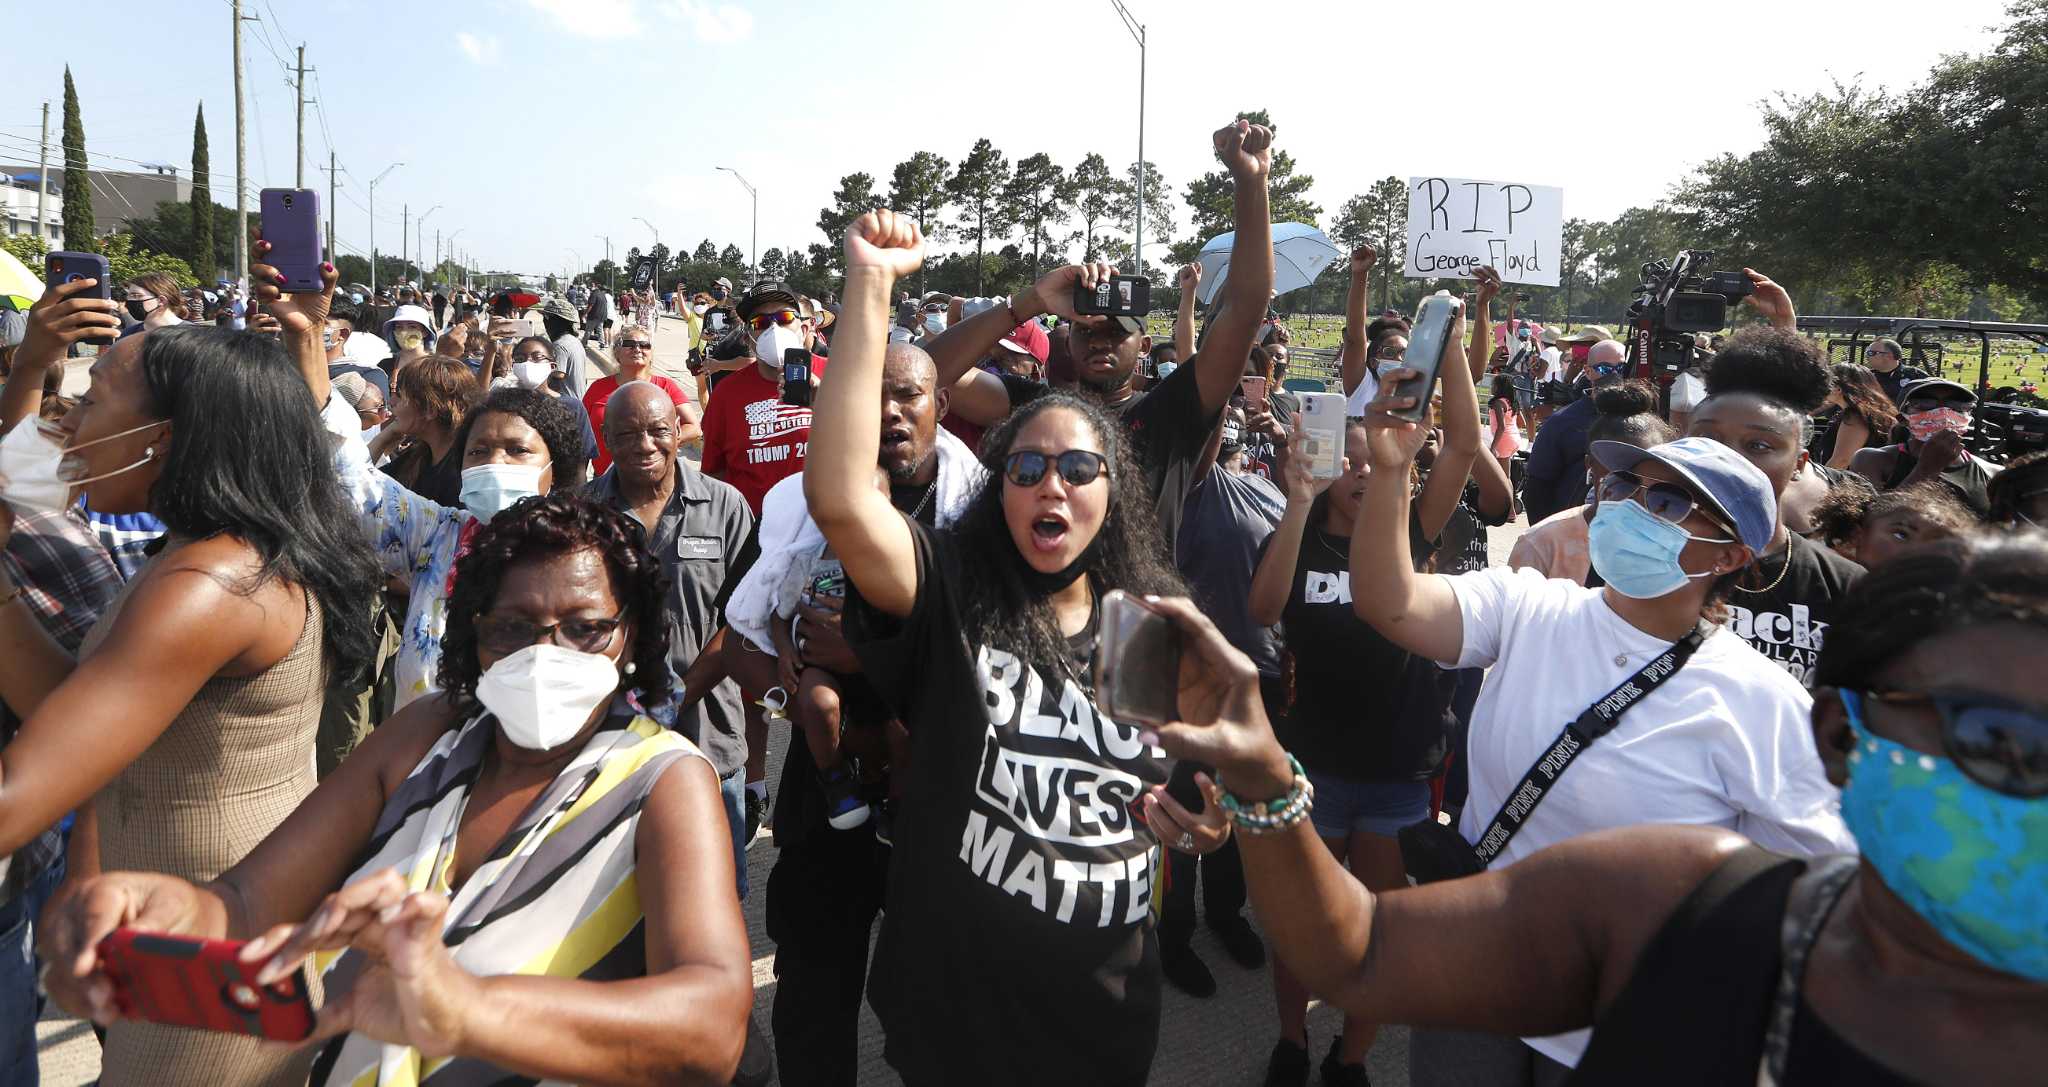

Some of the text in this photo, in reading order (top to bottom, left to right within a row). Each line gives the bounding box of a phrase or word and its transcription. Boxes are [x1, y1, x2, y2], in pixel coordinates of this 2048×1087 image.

[1417, 177, 1533, 234] RIP
[1414, 232, 1541, 280] George Floyd
[1639, 329, 1649, 365] Canon
[750, 422, 774, 436] USN
[746, 444, 790, 464] TRUMP
[1726, 603, 1830, 651] ack
[1744, 639, 1818, 665] ULAR
[976, 645, 1166, 760] BLAC
[1506, 779, 1542, 823] PINK
[1538, 733, 1580, 779] PINK
[1599, 681, 1643, 721] PINK
[1642, 652, 1676, 683] PIN
[980, 733, 1135, 839] LIVES
